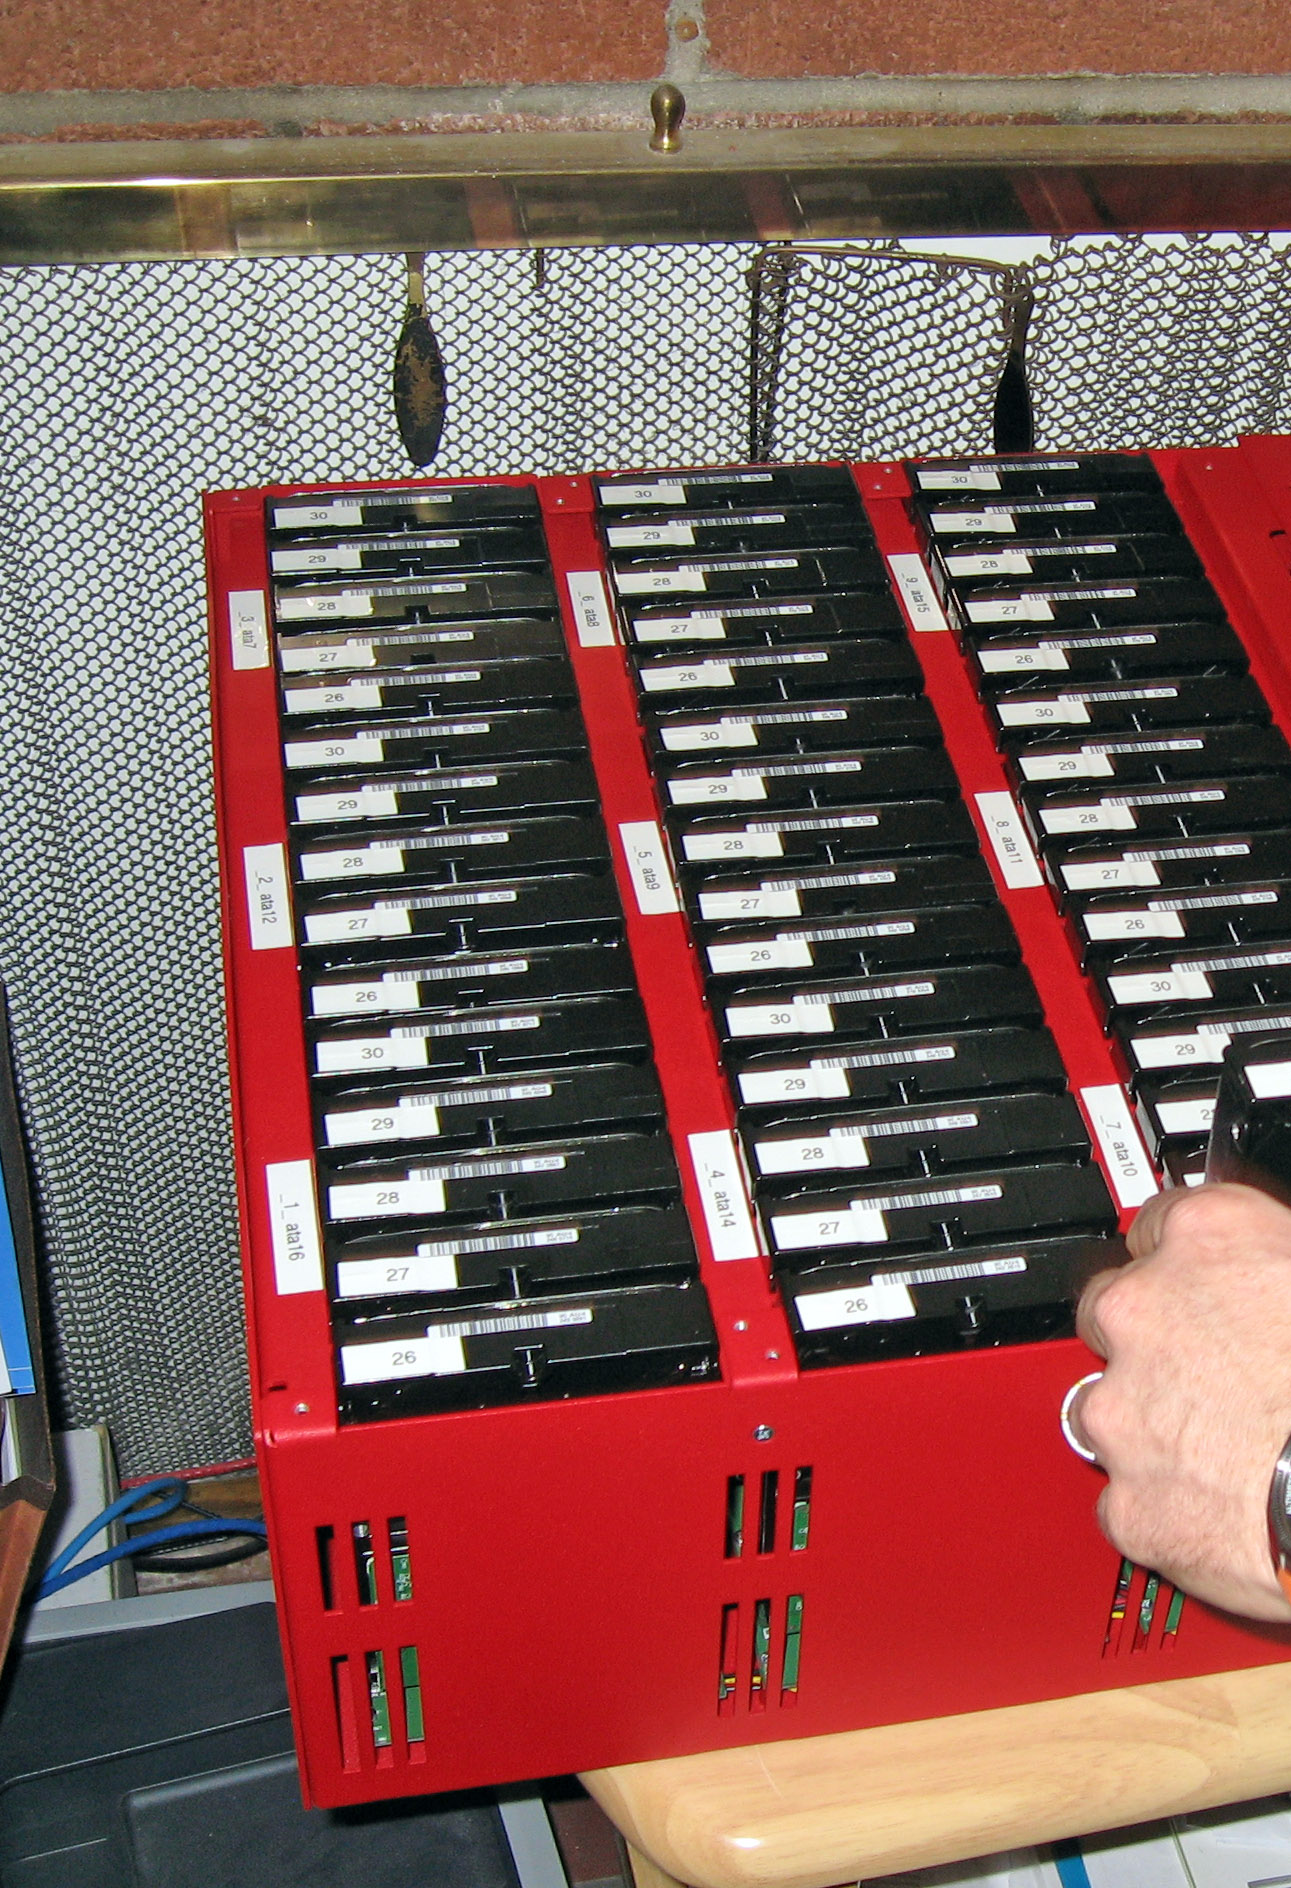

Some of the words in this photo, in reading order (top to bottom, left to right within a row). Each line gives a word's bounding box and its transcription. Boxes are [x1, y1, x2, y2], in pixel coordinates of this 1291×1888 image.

[951, 476, 968, 484] 30
[635, 491, 653, 499] 30
[309, 512, 328, 521] 30
[966, 519, 983, 527] 29
[643, 532, 661, 540] 29
[309, 555, 327, 564] 29
[981, 561, 999, 569] 28
[653, 578, 672, 587] 28
[318, 602, 336, 611] 28
[1002, 606, 1018, 615] 27
[671, 625, 689, 634] 27
[319, 653, 337, 662] 27
[1015, 655, 1033, 664] 26
[679, 672, 697, 681] 26
[325, 693, 344, 702] 26
[1036, 709, 1054, 718] 30
[700, 731, 719, 741] 30
[325, 747, 344, 756] 30
[1059, 761, 1076, 770] 29
[708, 784, 727, 794] 29
[338, 800, 357, 810] 29
[1080, 814, 1098, 823] 28
[724, 841, 743, 850] 28
[343, 857, 363, 868] 28
[1102, 869, 1119, 879] 27
[741, 899, 759, 909] 27
[348, 918, 368, 930] 27
[1125, 920, 1144, 929] 26
[751, 950, 771, 961] 26
[1151, 981, 1171, 992] 30
[356, 991, 377, 1002] 26
[770, 1013, 791, 1024] 30
[362, 1048, 384, 1059] 30
[1175, 1044, 1195, 1055] 29
[784, 1079, 805, 1090] 29
[372, 1118, 394, 1130] 29
[802, 1148, 824, 1160] 28
[377, 1192, 399, 1205] 28
[819, 1222, 839, 1235] 27
[387, 1268, 409, 1282] 27
[845, 1299, 868, 1313] 26
[393, 1351, 416, 1365] 26
